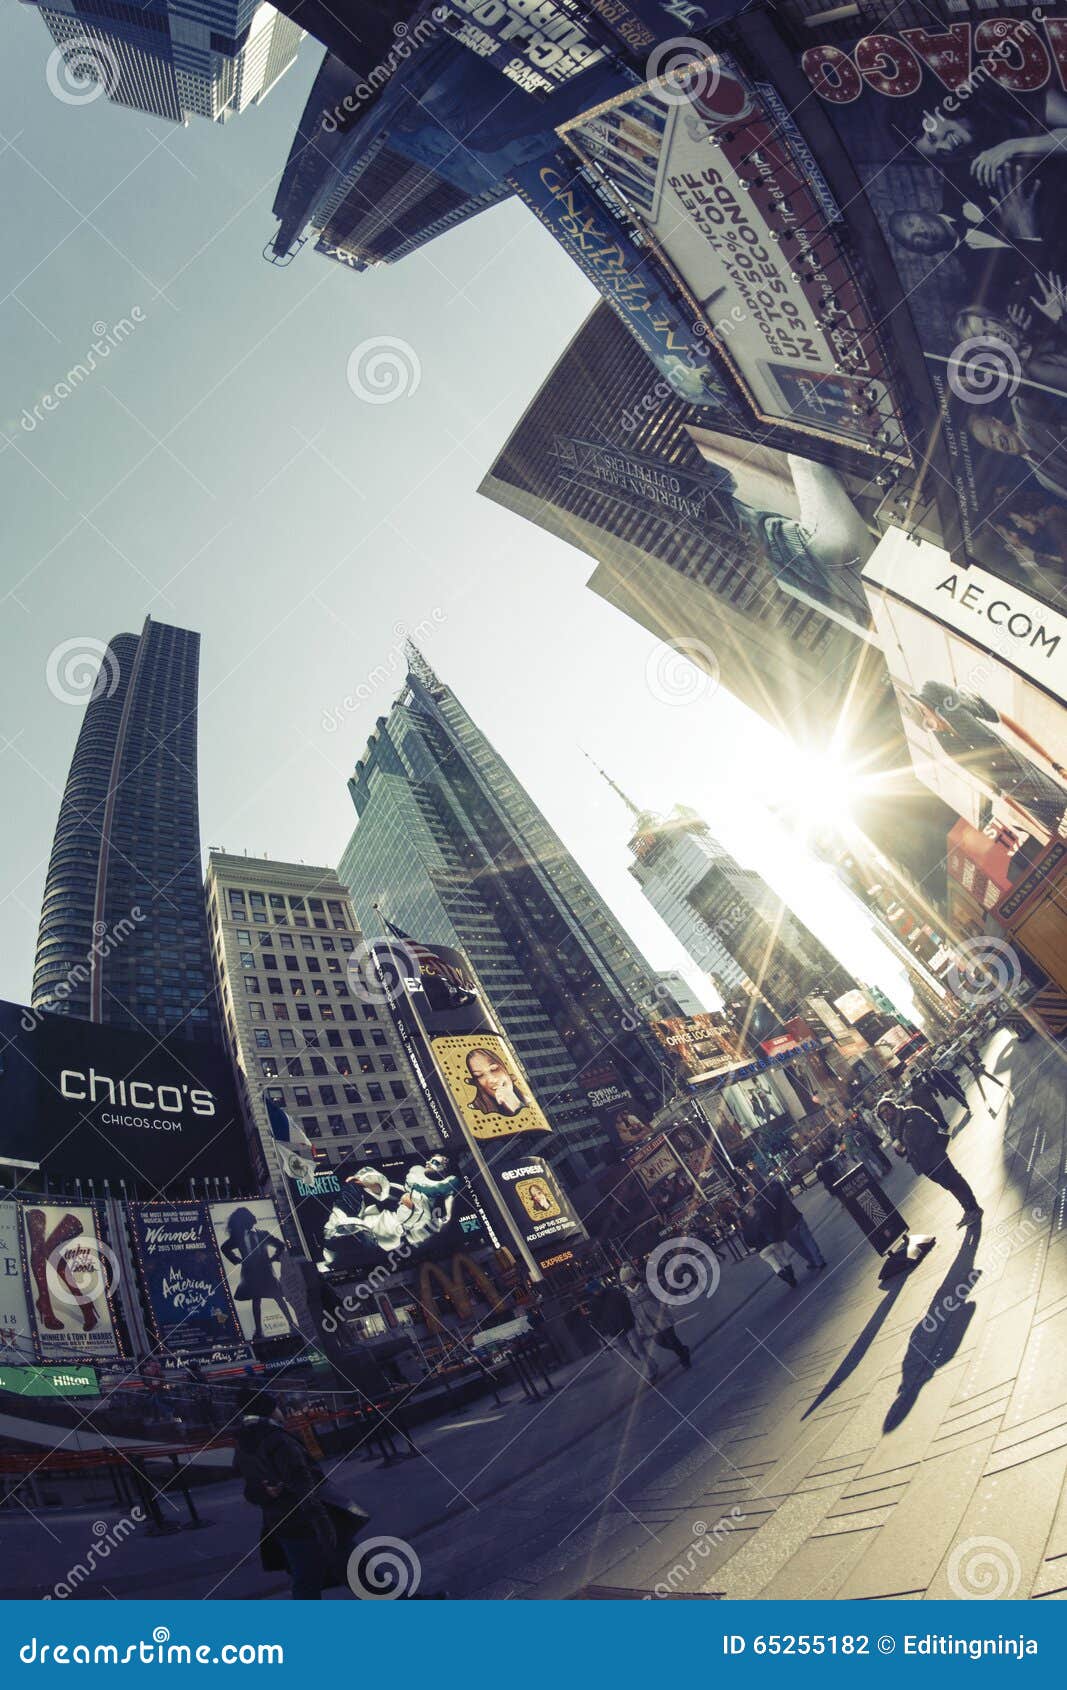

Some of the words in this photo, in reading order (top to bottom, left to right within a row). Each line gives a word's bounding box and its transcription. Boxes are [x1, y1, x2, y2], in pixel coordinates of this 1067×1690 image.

[616, 21, 649, 51] 2015
[667, 176, 724, 252] TICKETS
[681, 173, 727, 225] OFF
[532, 205, 559, 235] NEW
[700, 168, 789, 296] SECONDS
[538, 163, 687, 349] NEVERLAND
[557, 235, 599, 284] BIGGEST
[558, 214, 642, 313] FINDING
[720, 231, 765, 285] 50%
[723, 260, 784, 357] BROADWAY
[755, 290, 784, 320] TO
[775, 300, 806, 331] 30
[773, 326, 803, 357] UP
[795, 337, 822, 361] IN
[627, 479, 704, 517] AMERICAN
[935, 574, 1061, 658] AE.COM
[666, 1032, 694, 1046] OFFICE
[60, 1068, 215, 1116] chico's
[587, 1086, 617, 1102] SPRING
[101, 1113, 182, 1132] CHICOS.COM
[424, 1088, 433, 1101] ON
[429, 1101, 449, 1139] SNAPCHAT
[295, 1176, 341, 1197] BASKETS
[145, 1224, 203, 1243] Winner!
[541, 1251, 574, 1269] EXPRESS
[162, 1278, 215, 1298] American
[53, 1375, 89, 1386] Hilton
